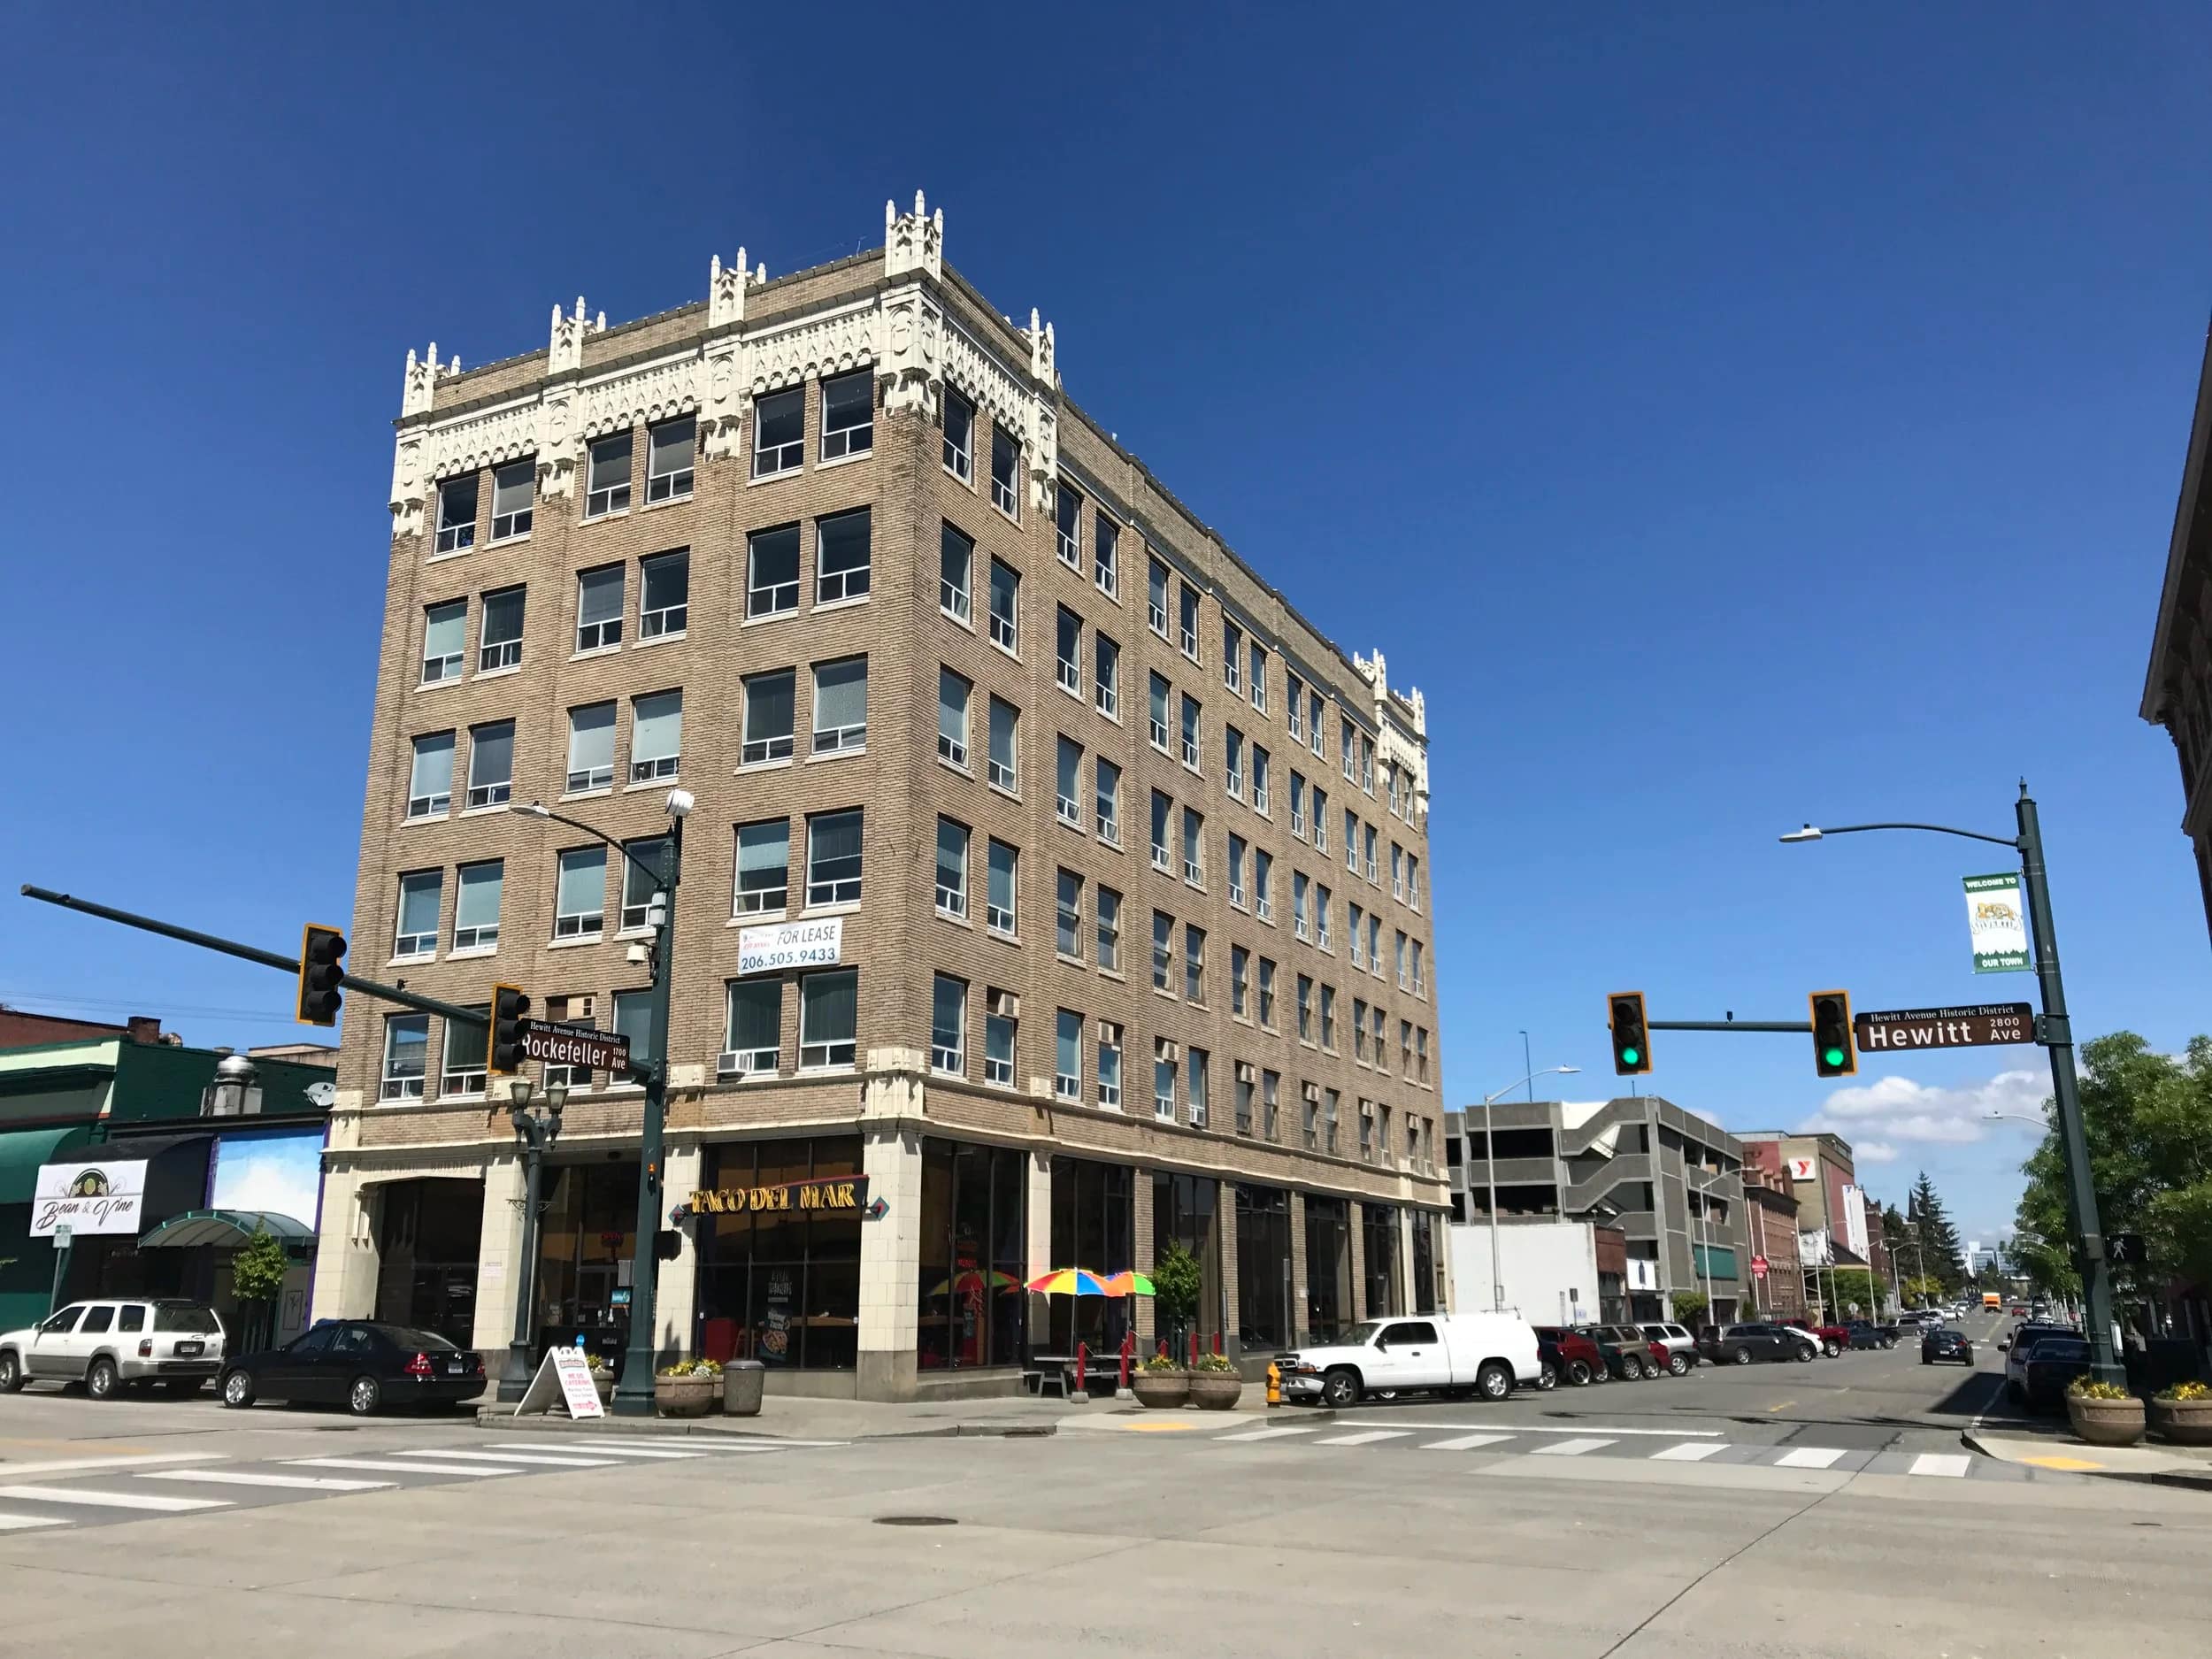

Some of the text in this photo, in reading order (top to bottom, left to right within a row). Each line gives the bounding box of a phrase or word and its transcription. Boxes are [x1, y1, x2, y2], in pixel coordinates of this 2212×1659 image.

[1966, 879, 2004, 888] WELCOME
[778, 930, 799, 945] FOR
[802, 926, 835, 942] LEASE
[741, 947, 835, 970] 206.505.9433
[1982, 957, 2024, 967] OUR TOWN
[1904, 1011, 1937, 1020] Avenue
[1939, 1008, 1977, 1018] Historic
[1978, 1005, 2015, 1016] District
[1991, 1018, 2019, 1027] 2800
[530, 1020, 621, 1044] Hewitt Avenue Historic District
[1869, 1022, 2021, 1048] Hewitt Ave
[613, 1047, 626, 1056] 1700
[611, 1057, 626, 1069] Ave
[689, 1183, 856, 1213] TACO DEL MAR
[35, 1197, 134, 1229] Bean & Vine
